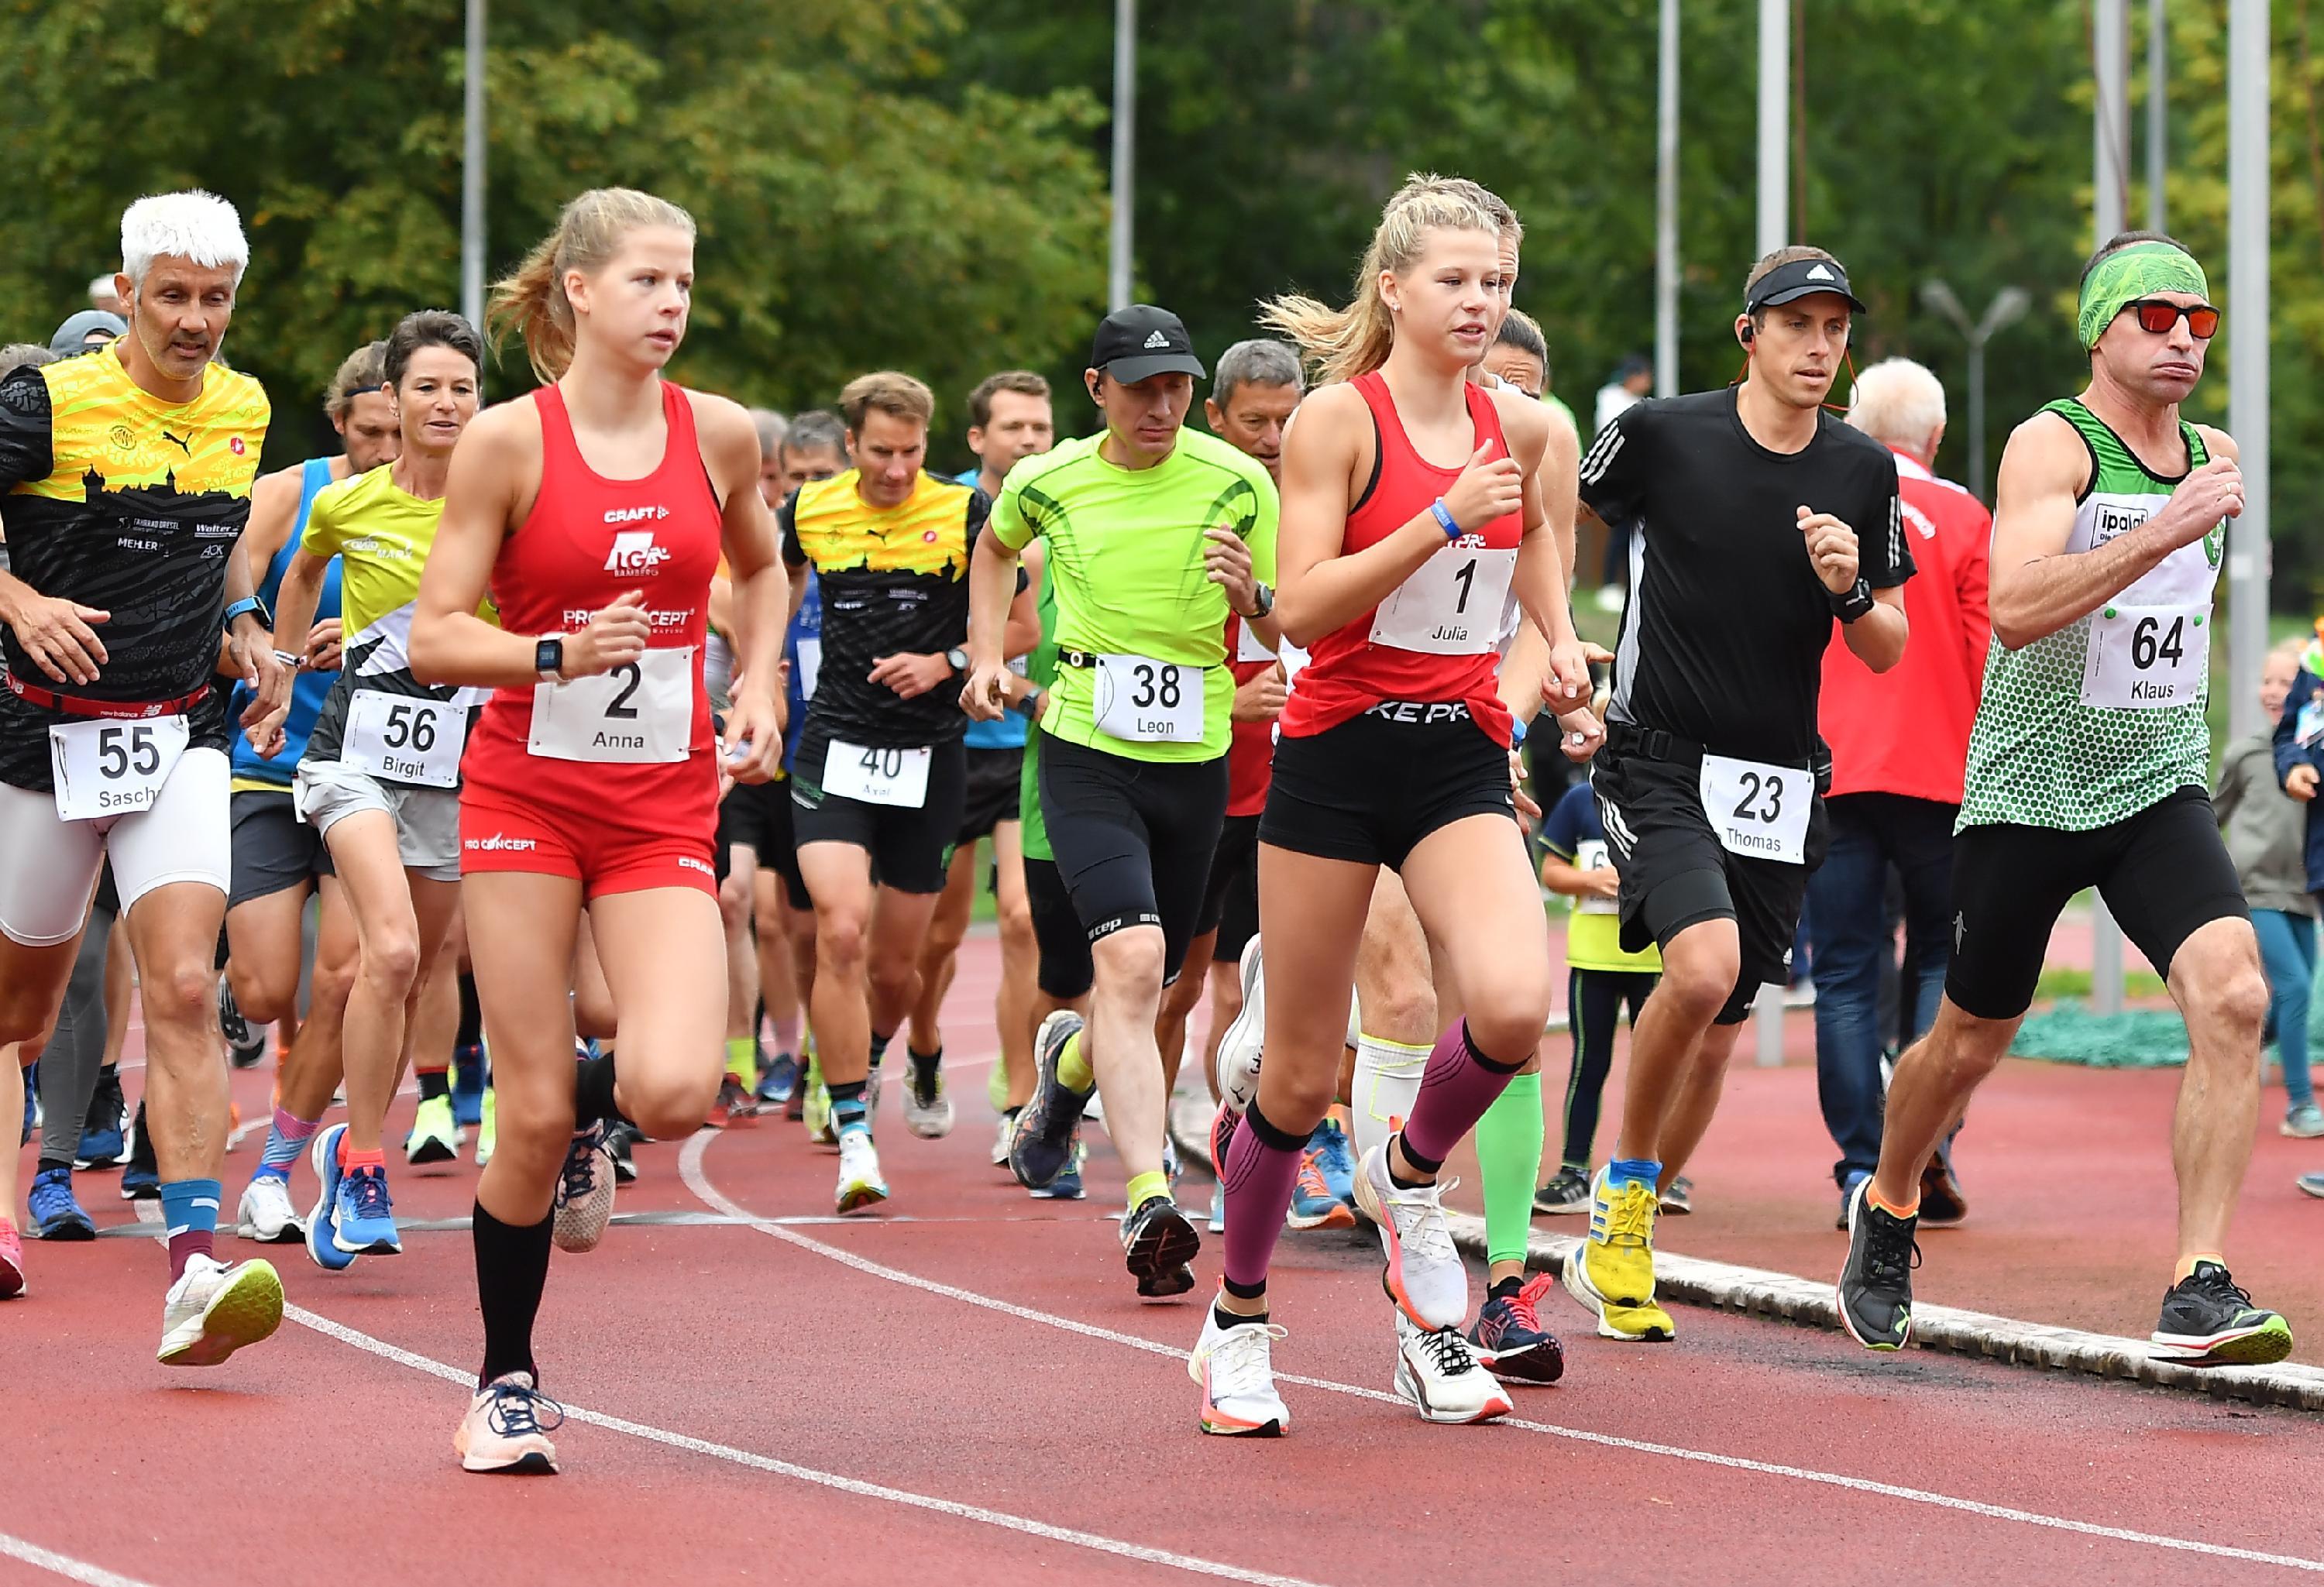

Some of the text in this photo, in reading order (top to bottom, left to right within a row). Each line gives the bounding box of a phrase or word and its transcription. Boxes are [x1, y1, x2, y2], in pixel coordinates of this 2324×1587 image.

[604, 507, 655, 523] CRAFT
[117, 538, 158, 551] MEHLER
[614, 569, 659, 577] BAMBERG
[1455, 559, 1477, 613] 1
[1432, 626, 1467, 641] Julia
[2132, 616, 2184, 670] 64
[604, 661, 641, 719] 2
[1132, 665, 1180, 708] 38
[2130, 681, 2174, 699] Klaus
[383, 705, 437, 752] 56
[1137, 718, 1174, 733] Leon
[592, 732, 644, 748] Anna
[99, 727, 160, 779] 55
[860, 748, 902, 778] 40
[383, 756, 425, 778] Birgit
[100, 787, 160, 808] Sasch
[1733, 772, 1783, 823] 23
[465, 840, 480, 850] PRO
[1727, 828, 1781, 852] Thomas
[1095, 918, 1122, 936] cep
